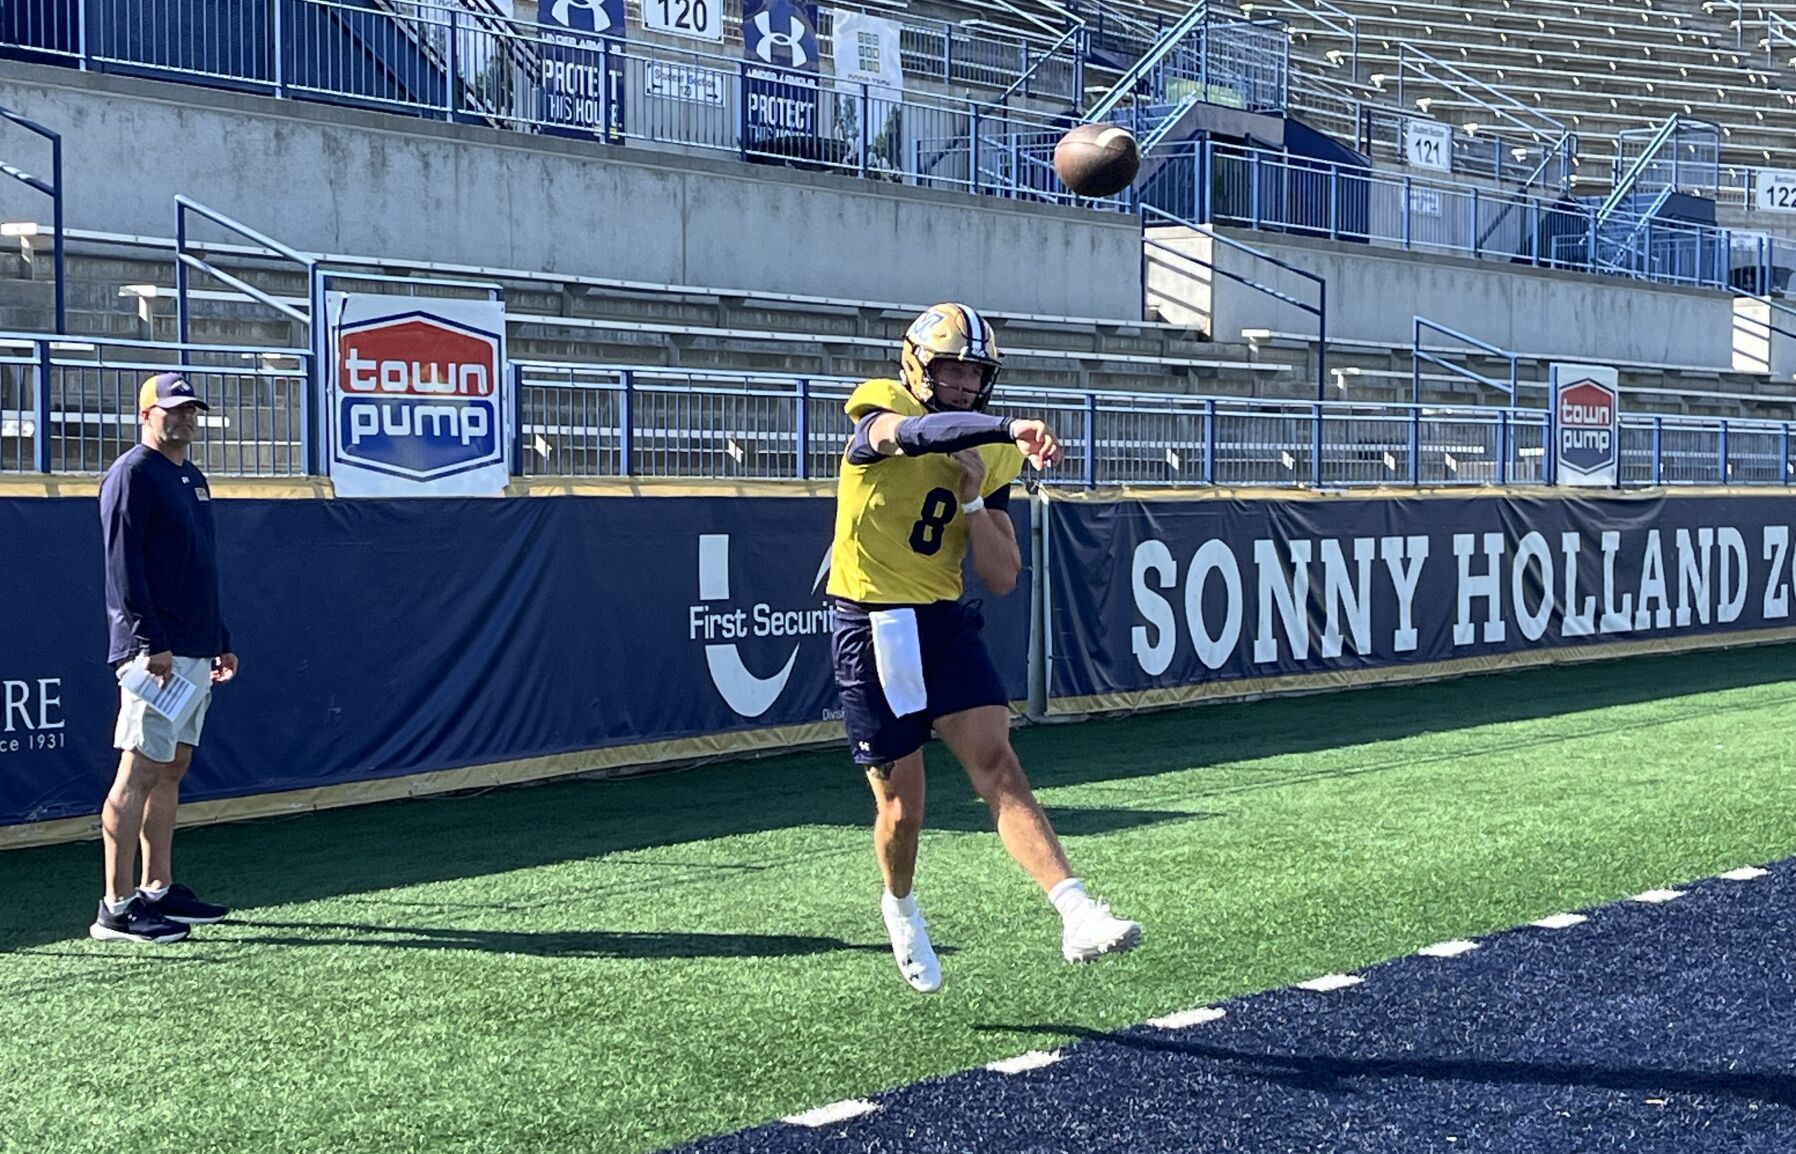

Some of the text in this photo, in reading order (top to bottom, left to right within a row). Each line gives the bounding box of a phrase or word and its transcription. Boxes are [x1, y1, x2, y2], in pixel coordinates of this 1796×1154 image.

[657, 0, 708, 33] 120
[541, 59, 623, 102] PROTET
[748, 92, 816, 130] PROTECT
[1415, 138, 1441, 165] 121
[345, 348, 488, 395] town
[350, 404, 488, 445] pump
[1562, 398, 1610, 425] town
[1563, 430, 1610, 455] pump
[908, 486, 958, 557] 8
[689, 600, 836, 639] First Securit
[1131, 525, 1796, 676] SONNY HOLLAND Z
[2, 678, 66, 732] RE
[29, 732, 65, 751] 1931
